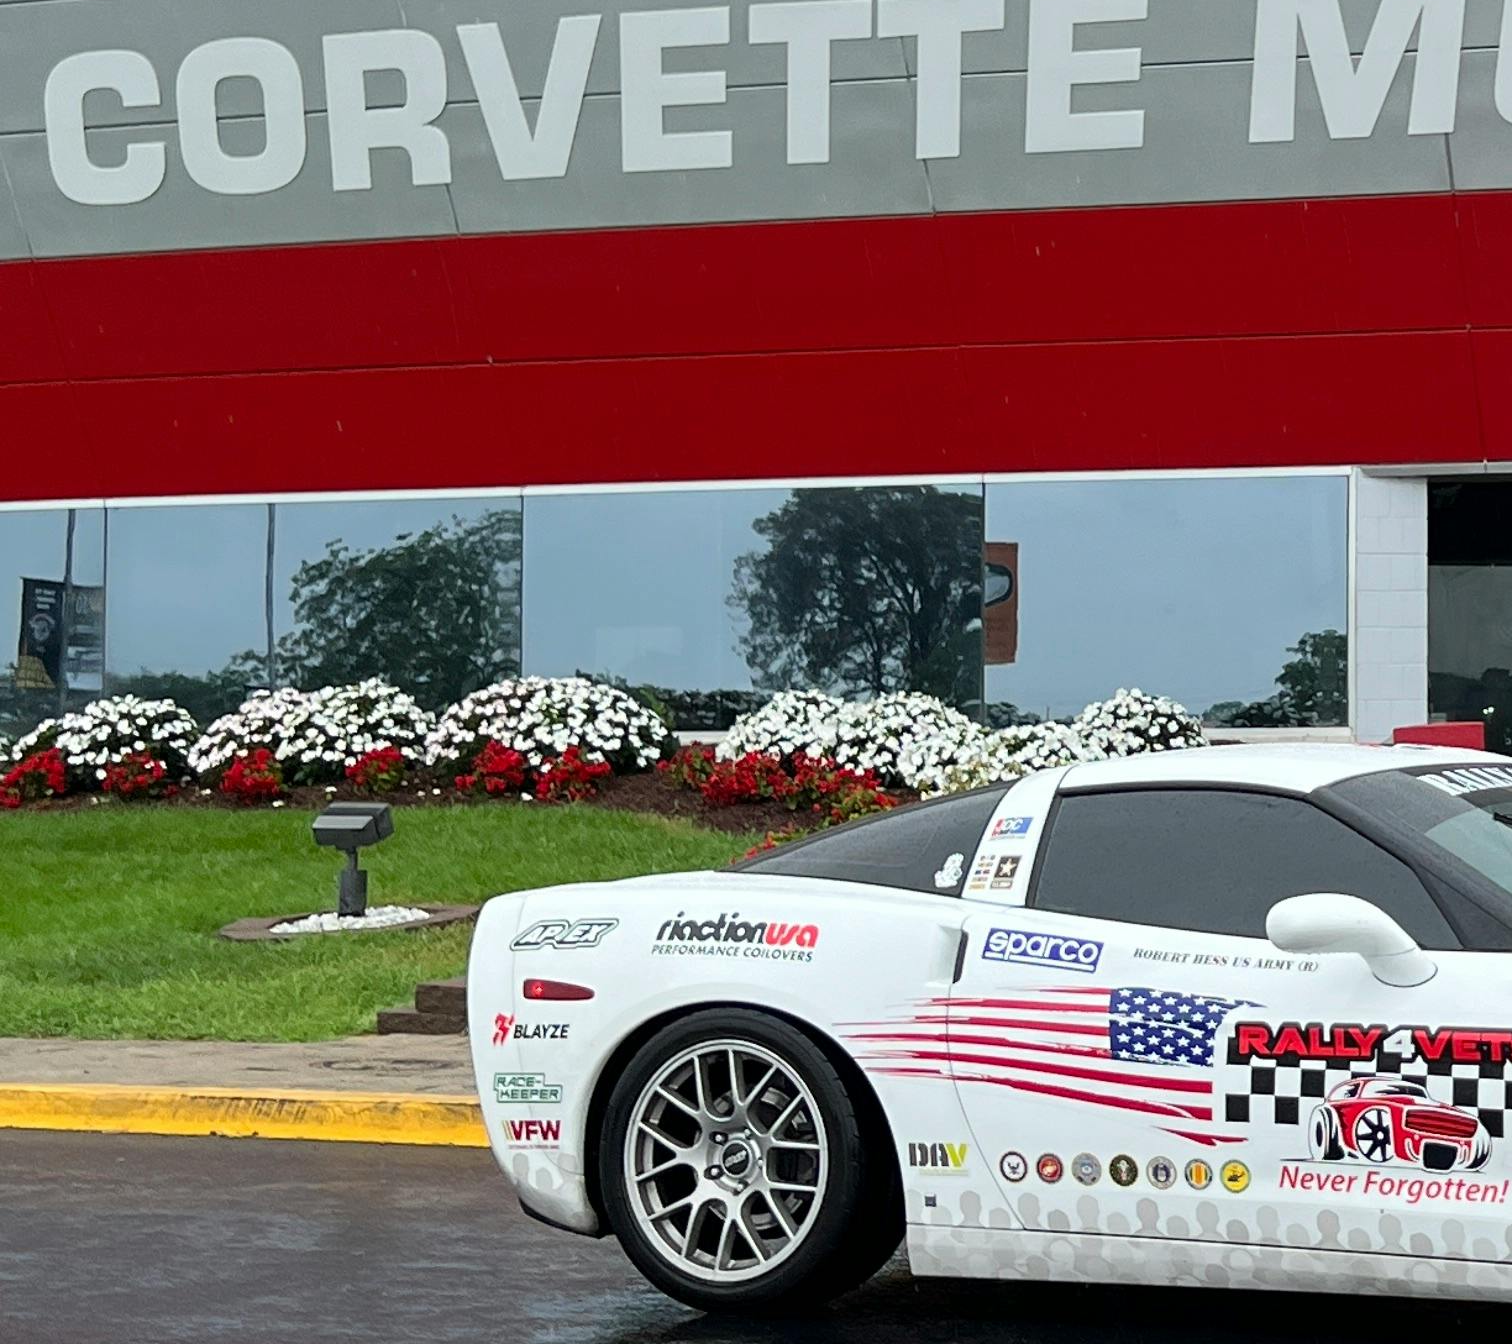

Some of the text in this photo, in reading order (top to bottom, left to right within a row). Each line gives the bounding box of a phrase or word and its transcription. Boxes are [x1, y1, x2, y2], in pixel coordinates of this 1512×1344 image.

[511, 919, 619, 951] APEX
[988, 930, 1100, 963] sparco
[651, 945, 814, 962] PERFORMANCE COILOVERS
[1133, 947, 1190, 965] ROBERT
[1231, 955, 1251, 968] US
[1253, 957, 1293, 971] ARMY
[513, 1024, 570, 1039] BLAYZE
[500, 1089, 559, 1100] KEEPER
[510, 1120, 561, 1141] VFW
[908, 1142, 968, 1168] DAV
[1279, 1165, 1510, 1204] Never Forgotten!
